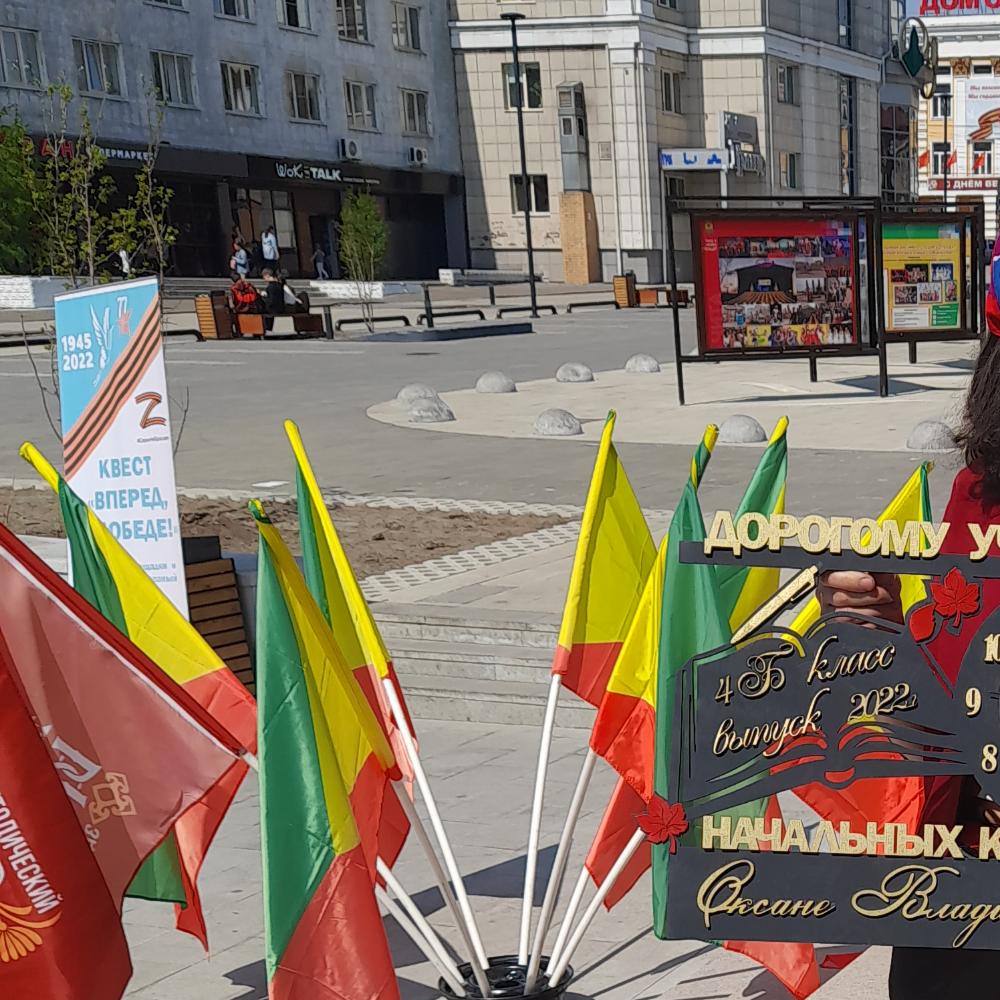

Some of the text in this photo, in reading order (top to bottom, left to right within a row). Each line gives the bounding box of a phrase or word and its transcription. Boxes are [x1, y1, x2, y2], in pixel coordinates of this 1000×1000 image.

[309, 167, 341, 181] TALK
[61, 333, 92, 353] 1945
[63, 351, 94, 371] 2022
[98, 456, 152, 479] КВЕСТ
[704, 510, 950, 559] ДОРОГОМУ
[714, 675, 734, 704] 4
[806, 636, 896, 684] класс
[965, 687, 981, 716] 9
[712, 688, 832, 757] выпуск
[981, 743, 998, 772] 8
[701, 815, 964, 860] НАЧАЛЬНЫХ
[696, 859, 836, 928] Оксане
